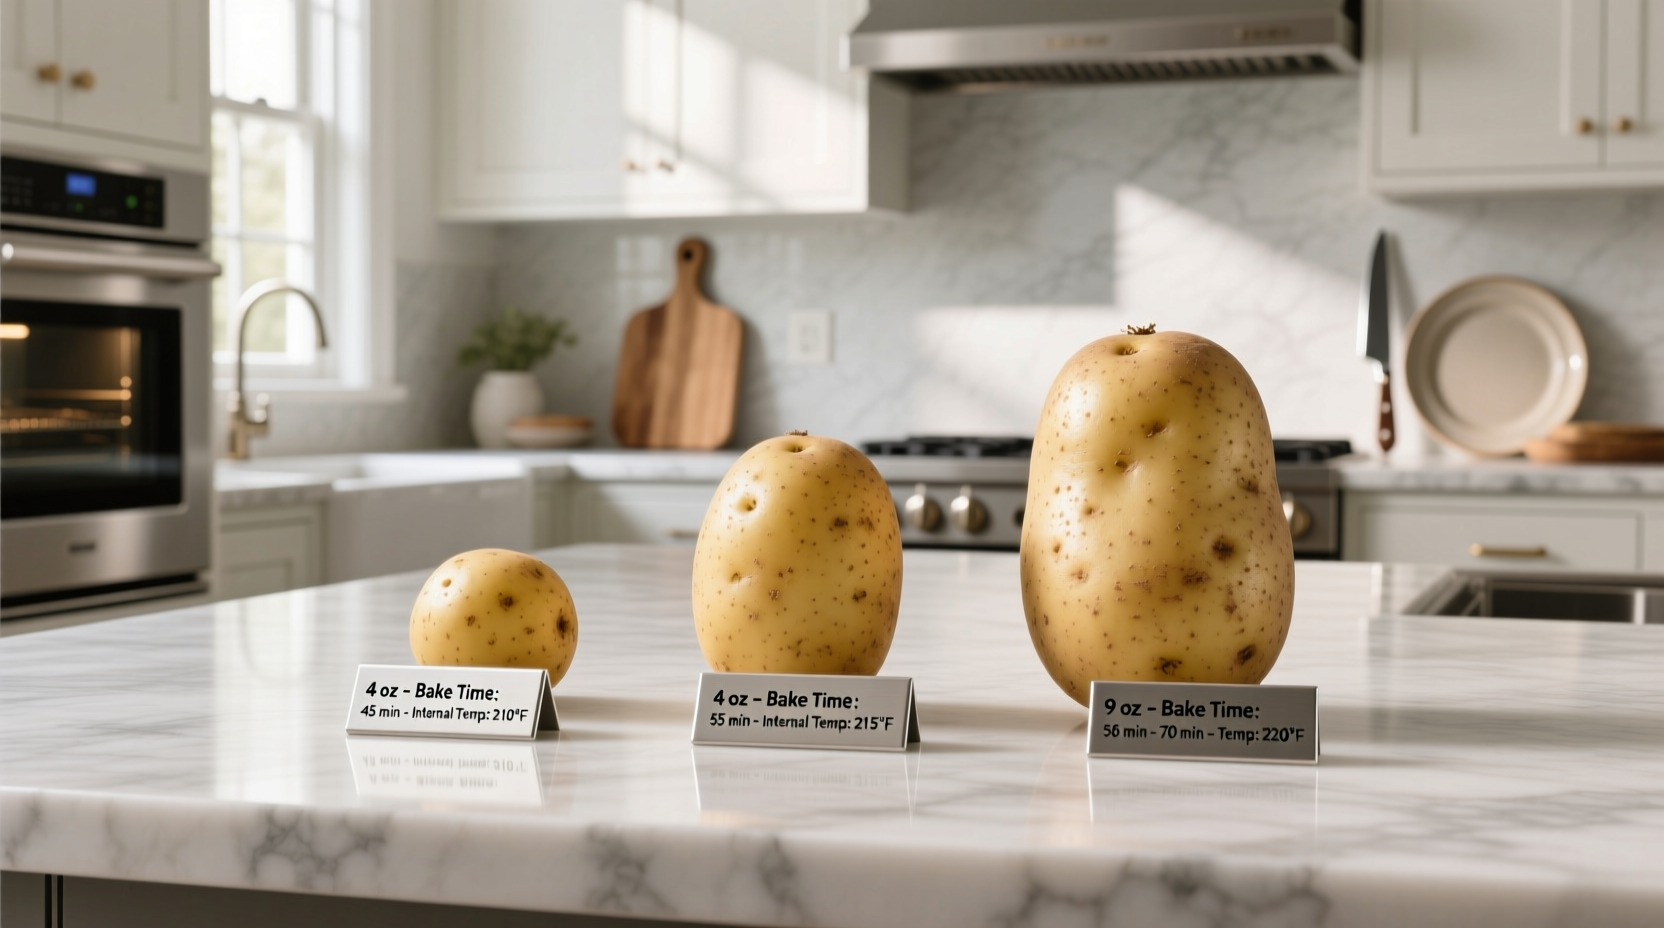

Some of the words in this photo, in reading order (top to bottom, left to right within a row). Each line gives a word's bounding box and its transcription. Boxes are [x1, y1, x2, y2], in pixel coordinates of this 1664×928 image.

[366, 682, 376, 696] 4
[380, 686, 398, 697] oz
[415, 683, 453, 699] Bake
[458, 684, 499, 701] Time:
[713, 690, 724, 705] 4
[728, 695, 748, 706] oz
[767, 691, 808, 707] Bake
[813, 692, 859, 709] Time:
[360, 705, 376, 717] 45
[379, 706, 400, 718] min
[412, 706, 453, 719] Internal
[1105, 699, 1116, 715] 9
[1120, 703, 1142, 716] oz
[1162, 700, 1205, 717] Bake
[1210, 701, 1259, 719] Time:
[710, 713, 726, 726] 55
[729, 714, 750, 726] min
[763, 715, 809, 728] Internal
[812, 715, 851, 733] Temp:
[1123, 725, 1147, 738] min
[1160, 725, 1177, 738] 70
[1180, 726, 1203, 739] min
[1218, 727, 1259, 745] Temp:
